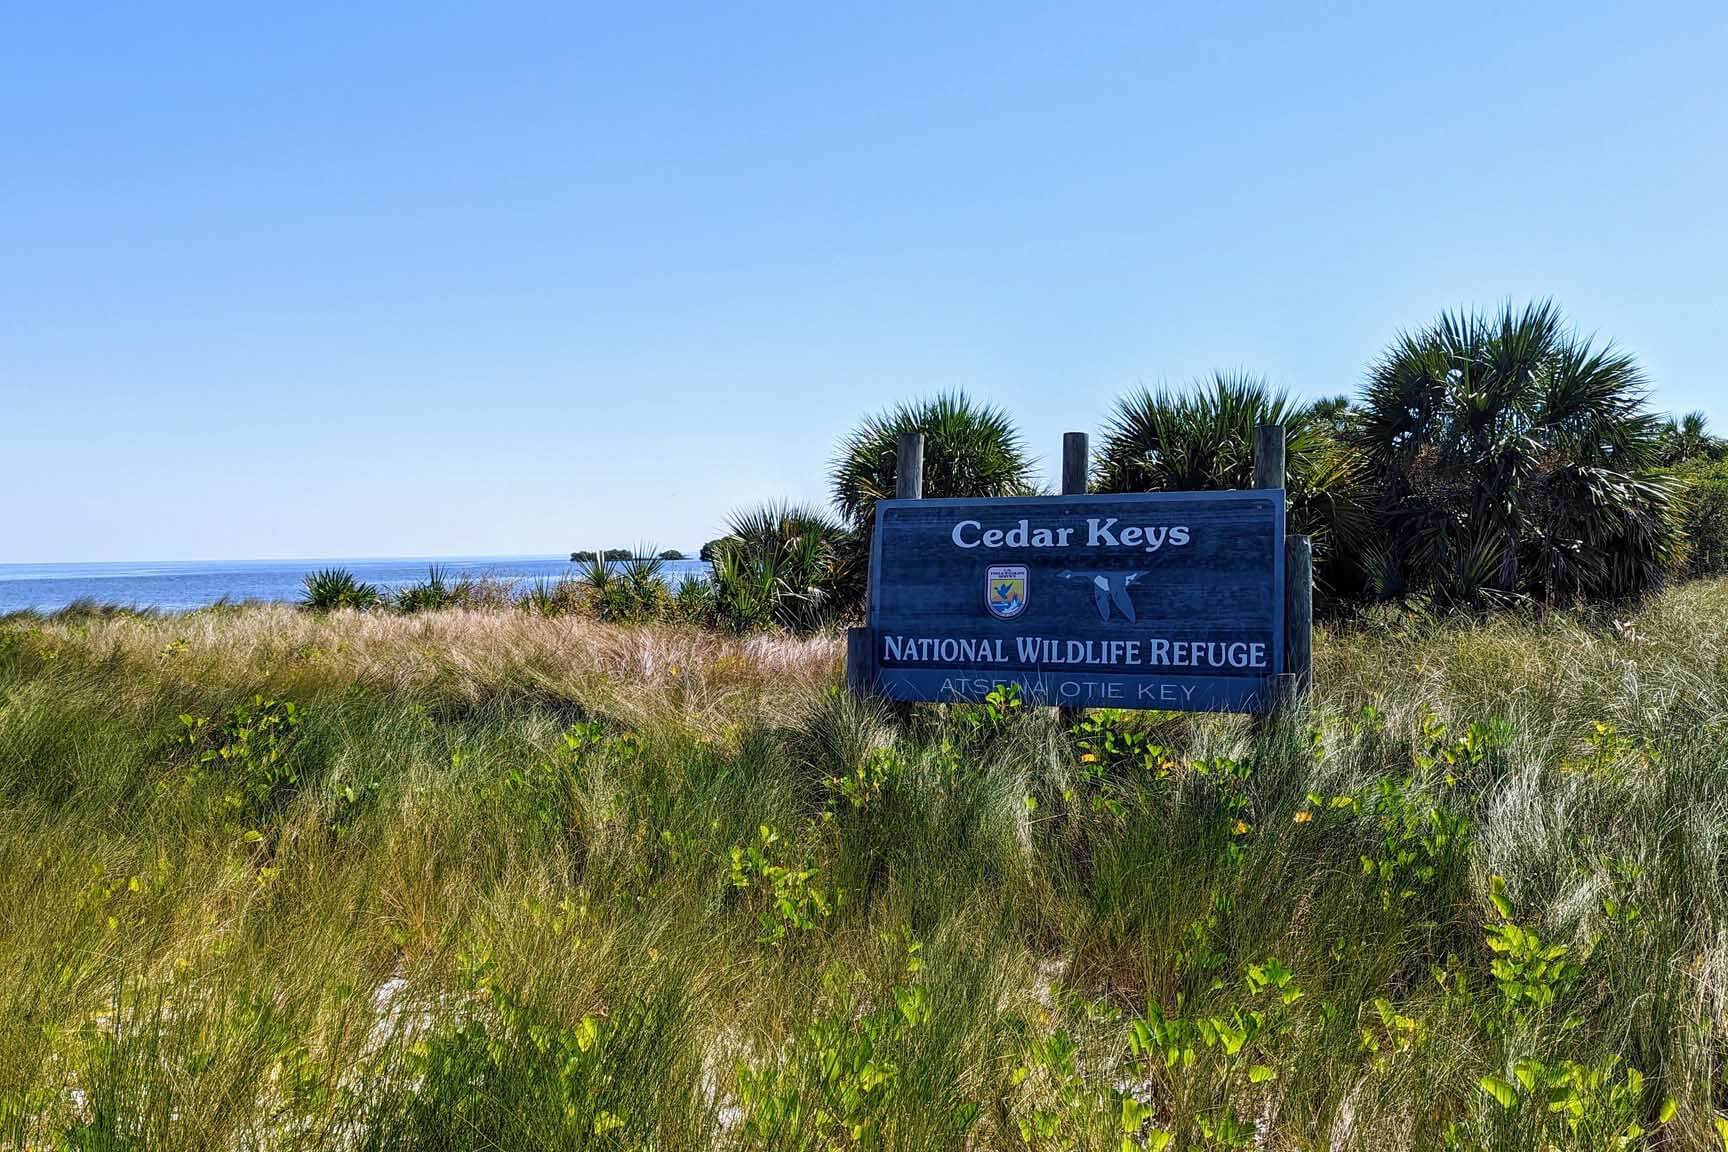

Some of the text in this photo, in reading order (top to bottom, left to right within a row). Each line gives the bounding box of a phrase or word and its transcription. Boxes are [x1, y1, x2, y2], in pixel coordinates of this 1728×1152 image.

[951, 518, 1190, 552] Cedar Keys
[883, 635, 1267, 667] NATIONAL WILDLIFE REFUGE
[1060, 681, 1124, 699] OTIE
[1138, 683, 1196, 701] KEY
